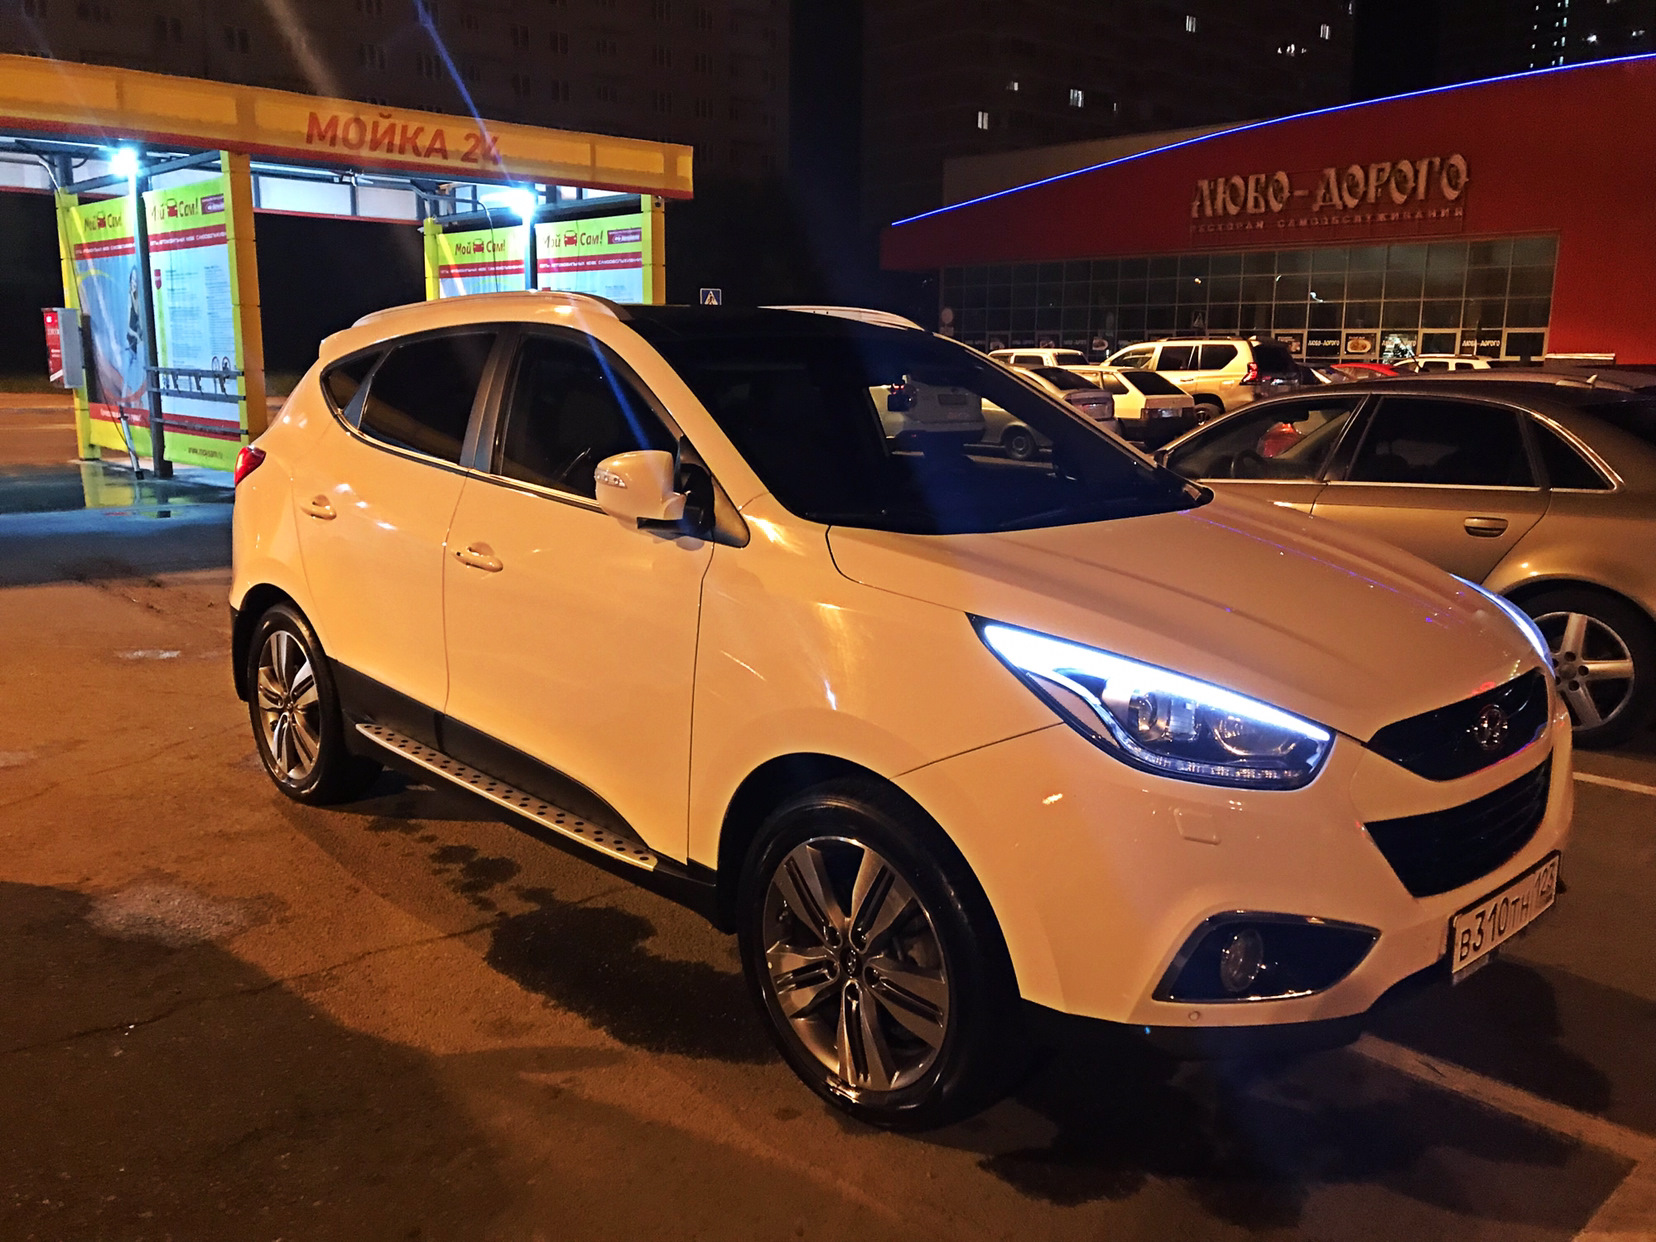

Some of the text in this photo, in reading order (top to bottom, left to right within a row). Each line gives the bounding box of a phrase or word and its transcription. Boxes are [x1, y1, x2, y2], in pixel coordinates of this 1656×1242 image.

[305, 111, 500, 166] МОЙКА 24
[580, 229, 604, 247] Сам!
[1459, 891, 1531, 962] В310ТН
